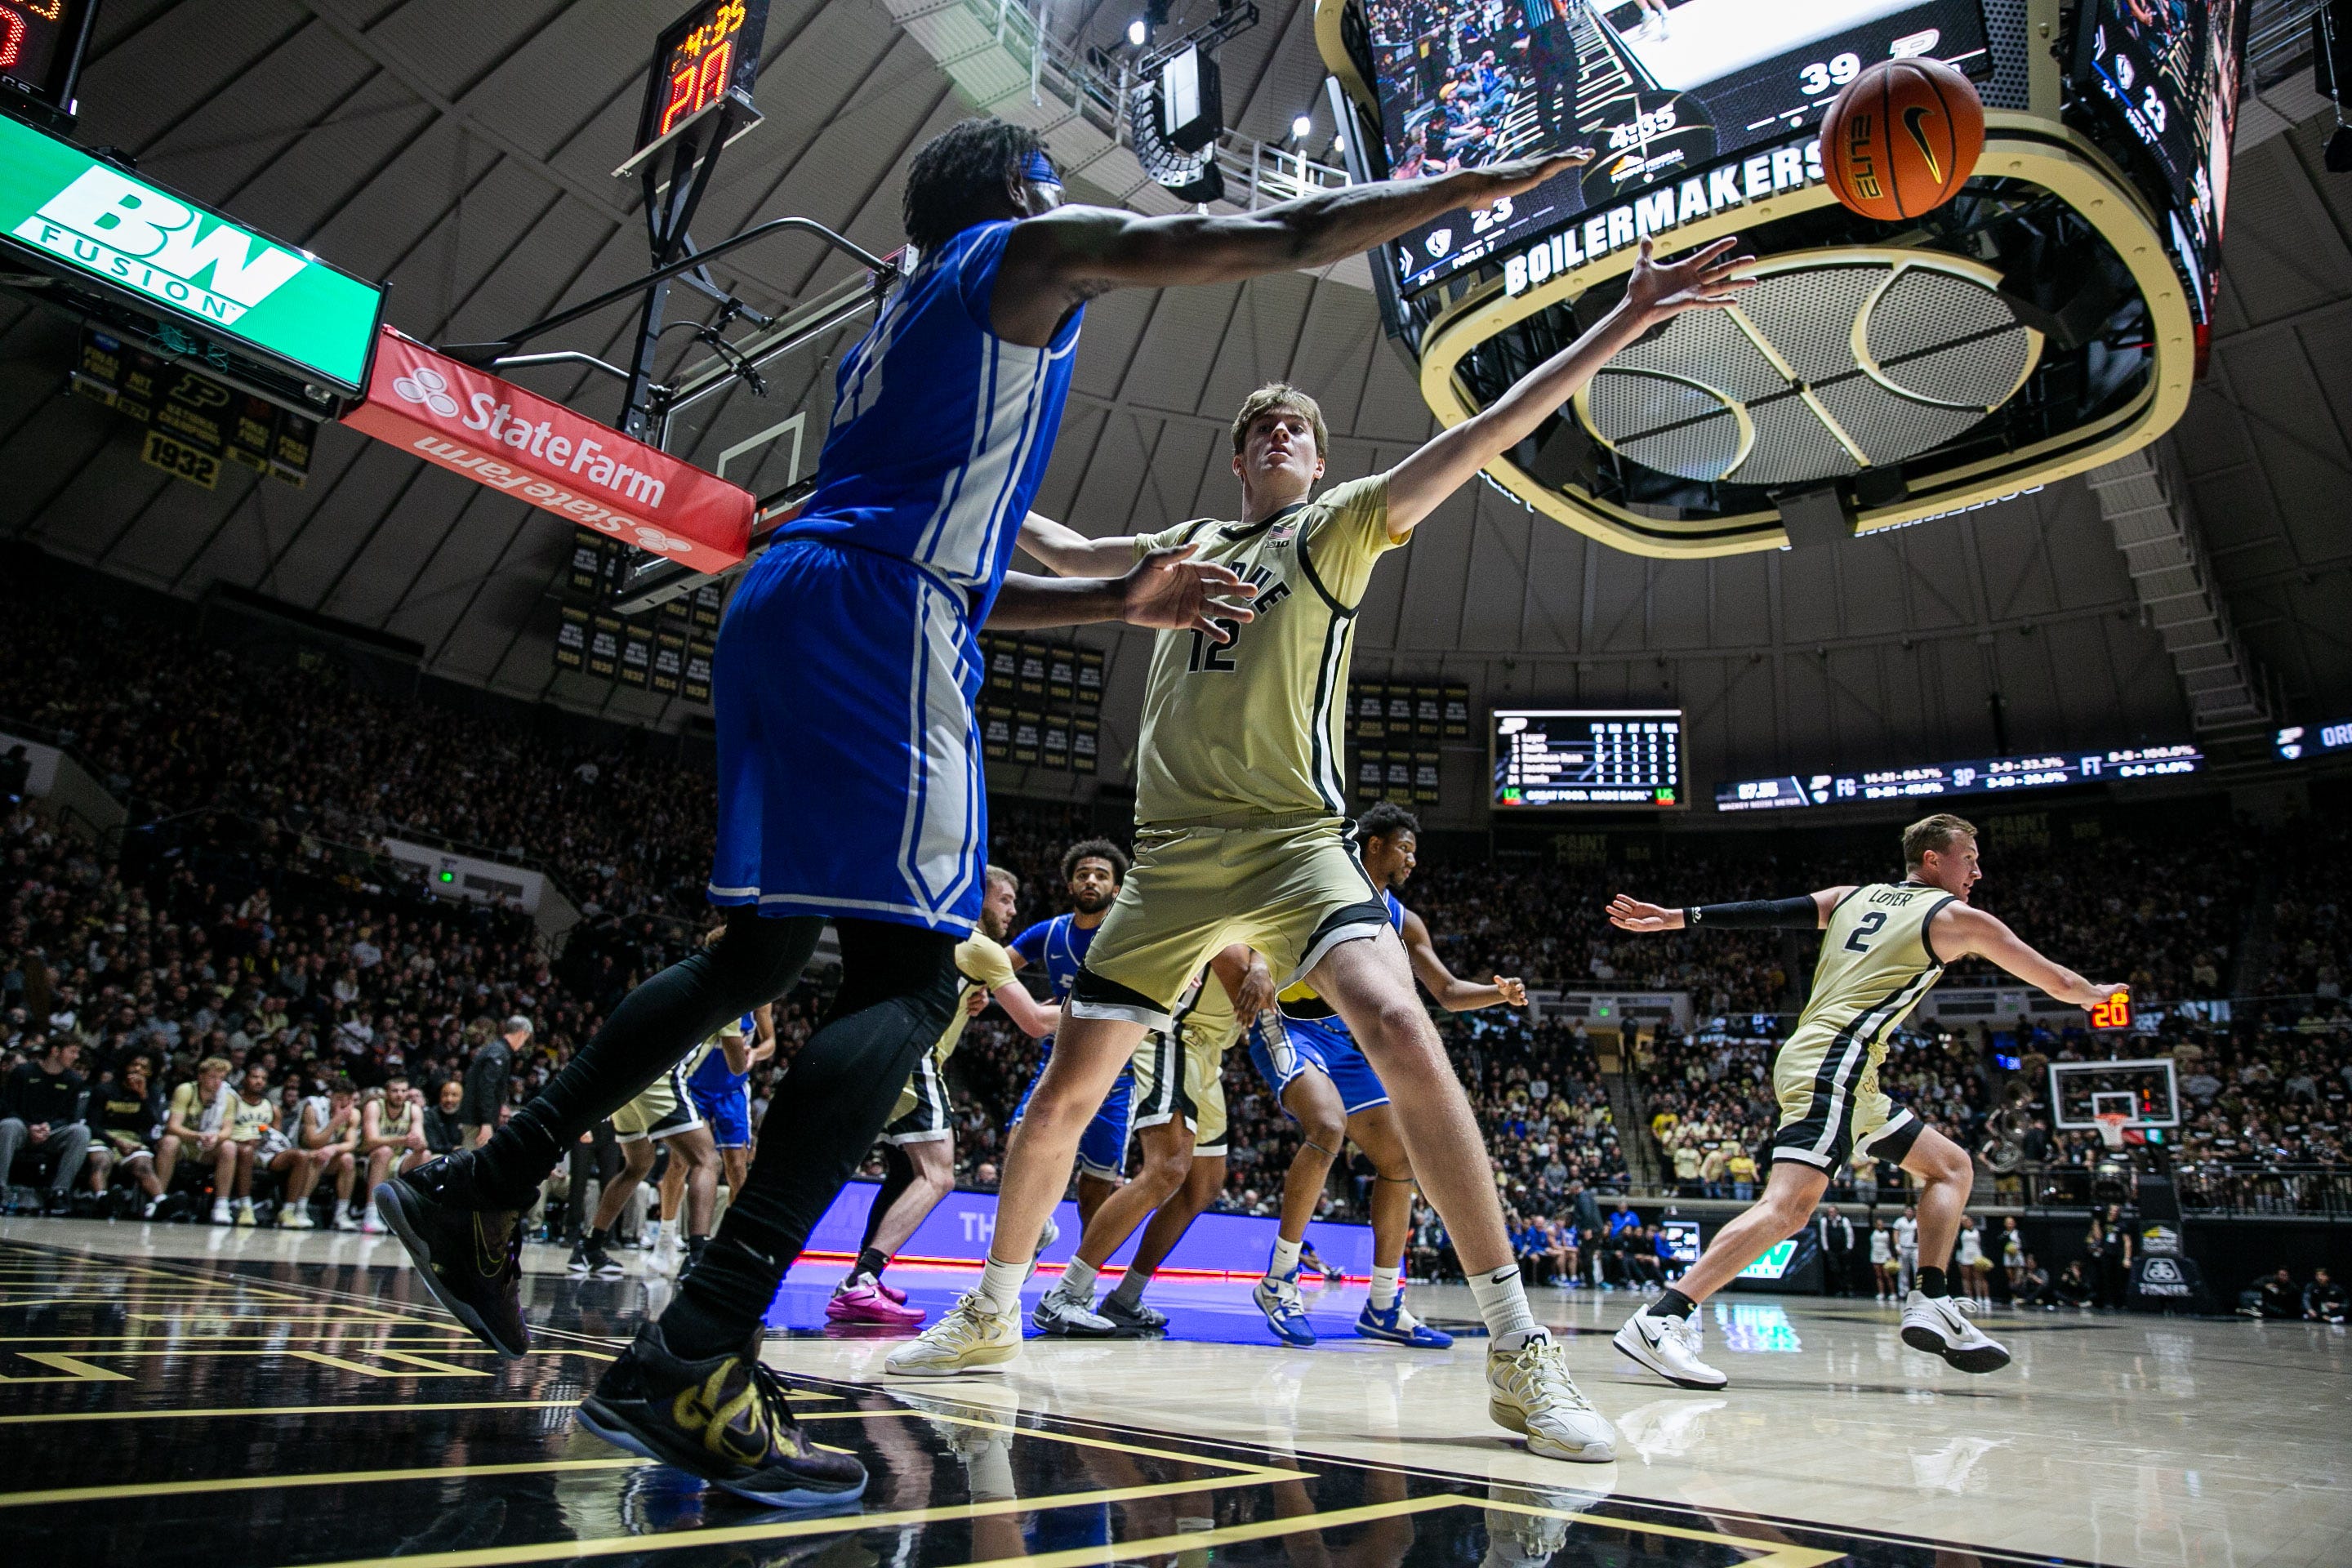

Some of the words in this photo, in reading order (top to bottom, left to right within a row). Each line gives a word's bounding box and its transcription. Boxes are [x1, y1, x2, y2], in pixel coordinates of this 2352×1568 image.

[1799, 52, 1861, 95] 39
[2142, 85, 2167, 133] 23
[1849, 113, 1883, 199] ELITE
[36, 164, 309, 309] BW
[1470, 196, 1514, 234] 23
[1504, 139, 1826, 297] BOILERMAKERS
[39, 224, 229, 319] FUSION
[149, 437, 216, 486] 1932
[1187, 617, 1242, 675] 12
[1953, 768, 1976, 787] 3P
[2081, 755, 2103, 776] FT
[1837, 778, 1857, 798] FG
[1868, 889, 1915, 907] LOYER
[1843, 911, 1888, 954] 2
[2092, 1002, 2129, 1027] 20
